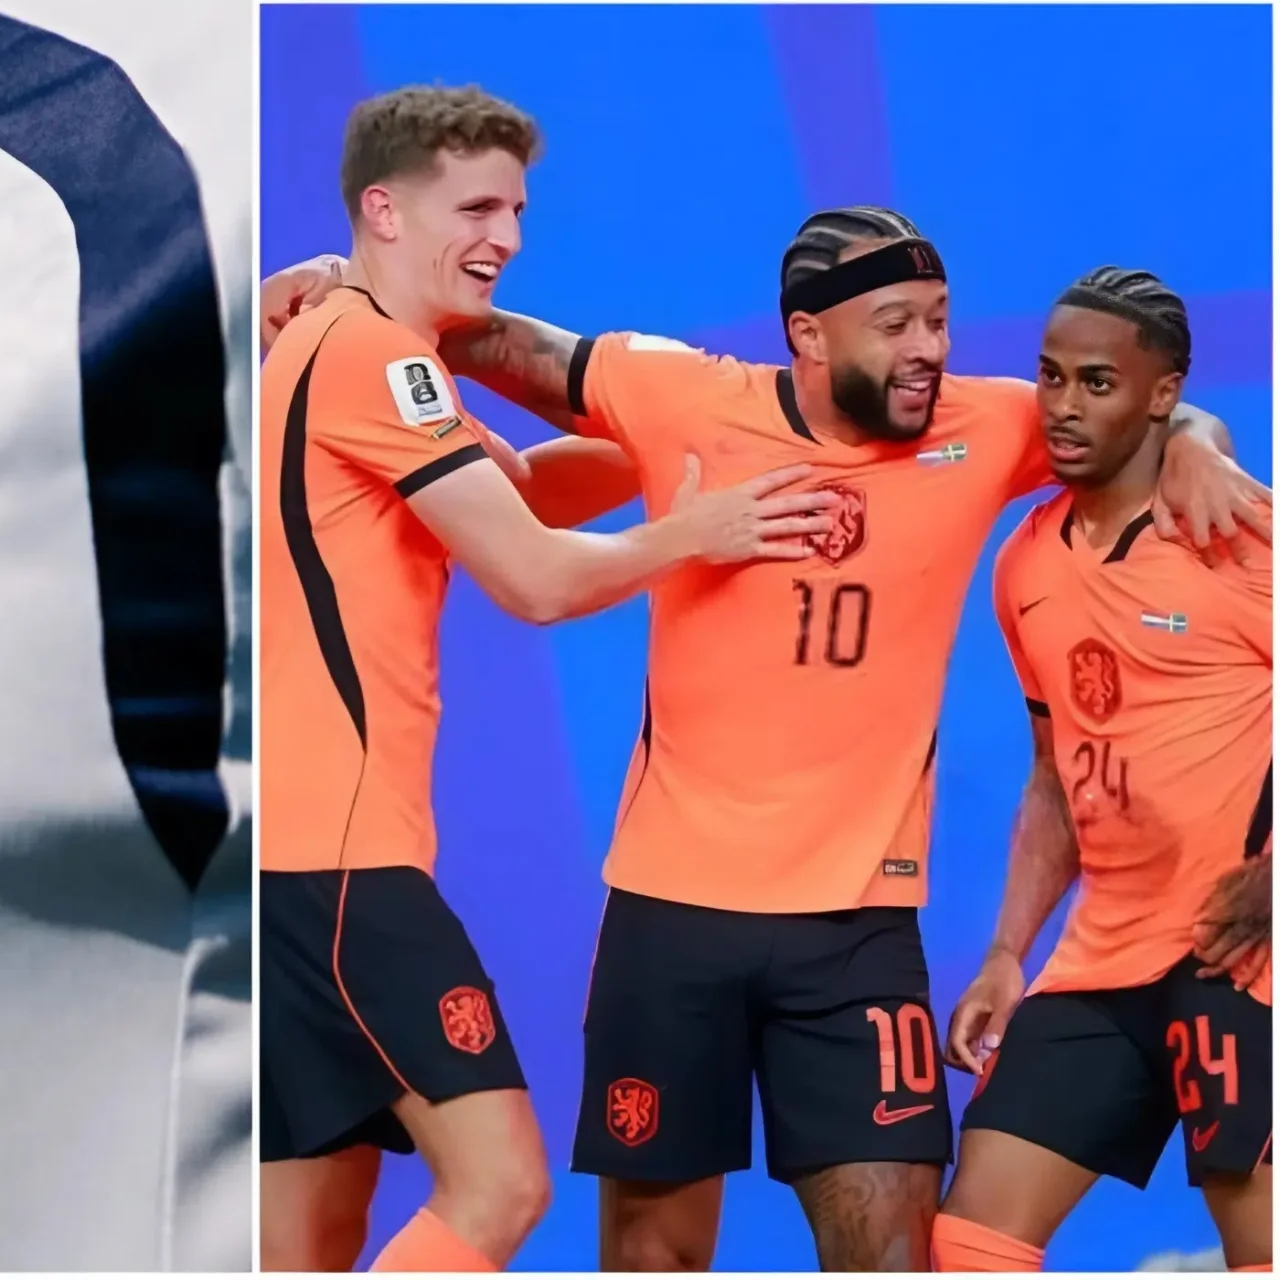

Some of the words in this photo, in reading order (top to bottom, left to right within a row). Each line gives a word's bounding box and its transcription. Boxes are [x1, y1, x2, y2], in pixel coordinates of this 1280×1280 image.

[792, 578, 873, 667] 10
[866, 1003, 936, 1093] 10
[1166, 1015, 1239, 1113] 24
